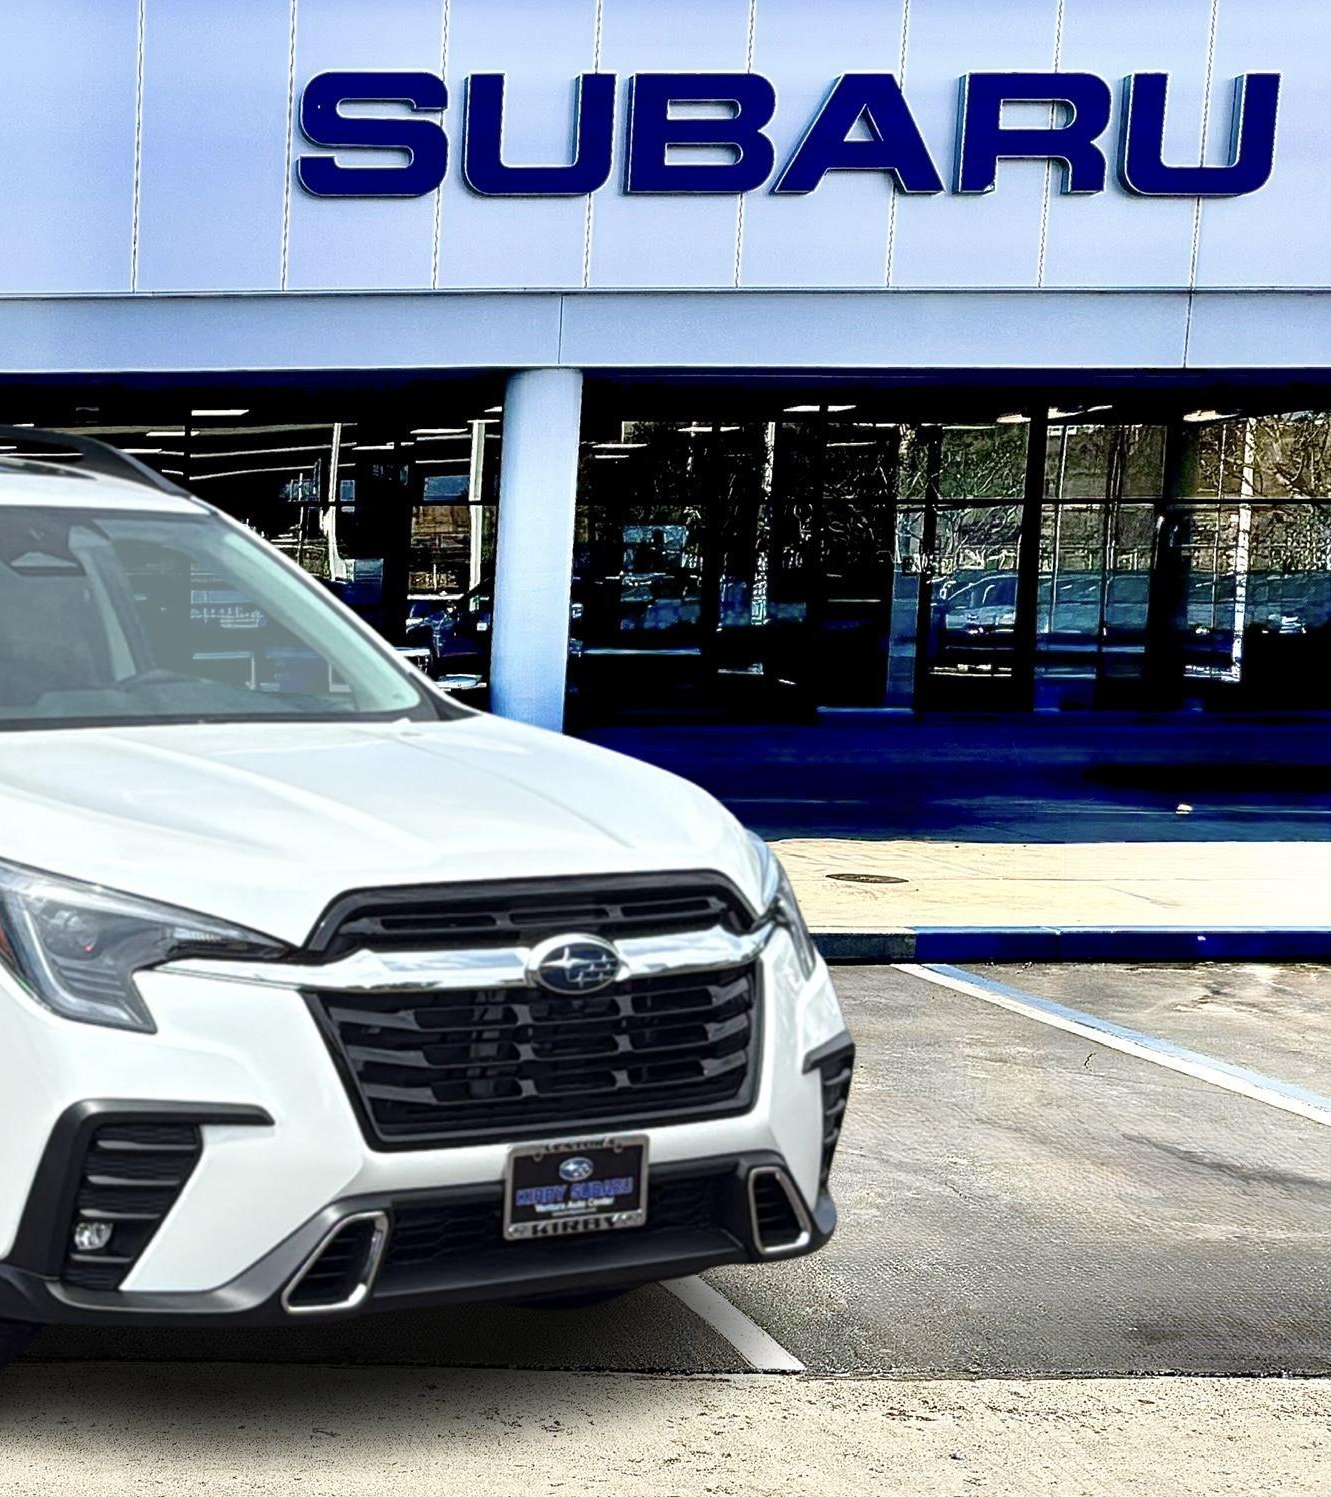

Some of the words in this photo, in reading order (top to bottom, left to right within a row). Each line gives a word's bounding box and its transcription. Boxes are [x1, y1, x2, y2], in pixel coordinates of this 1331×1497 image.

[297, 71, 1282, 197] SUBARU
[516, 1185, 567, 1206] KIRBY
[570, 1177, 633, 1199] SUBARU
[532, 1215, 618, 1235] KIRBY
